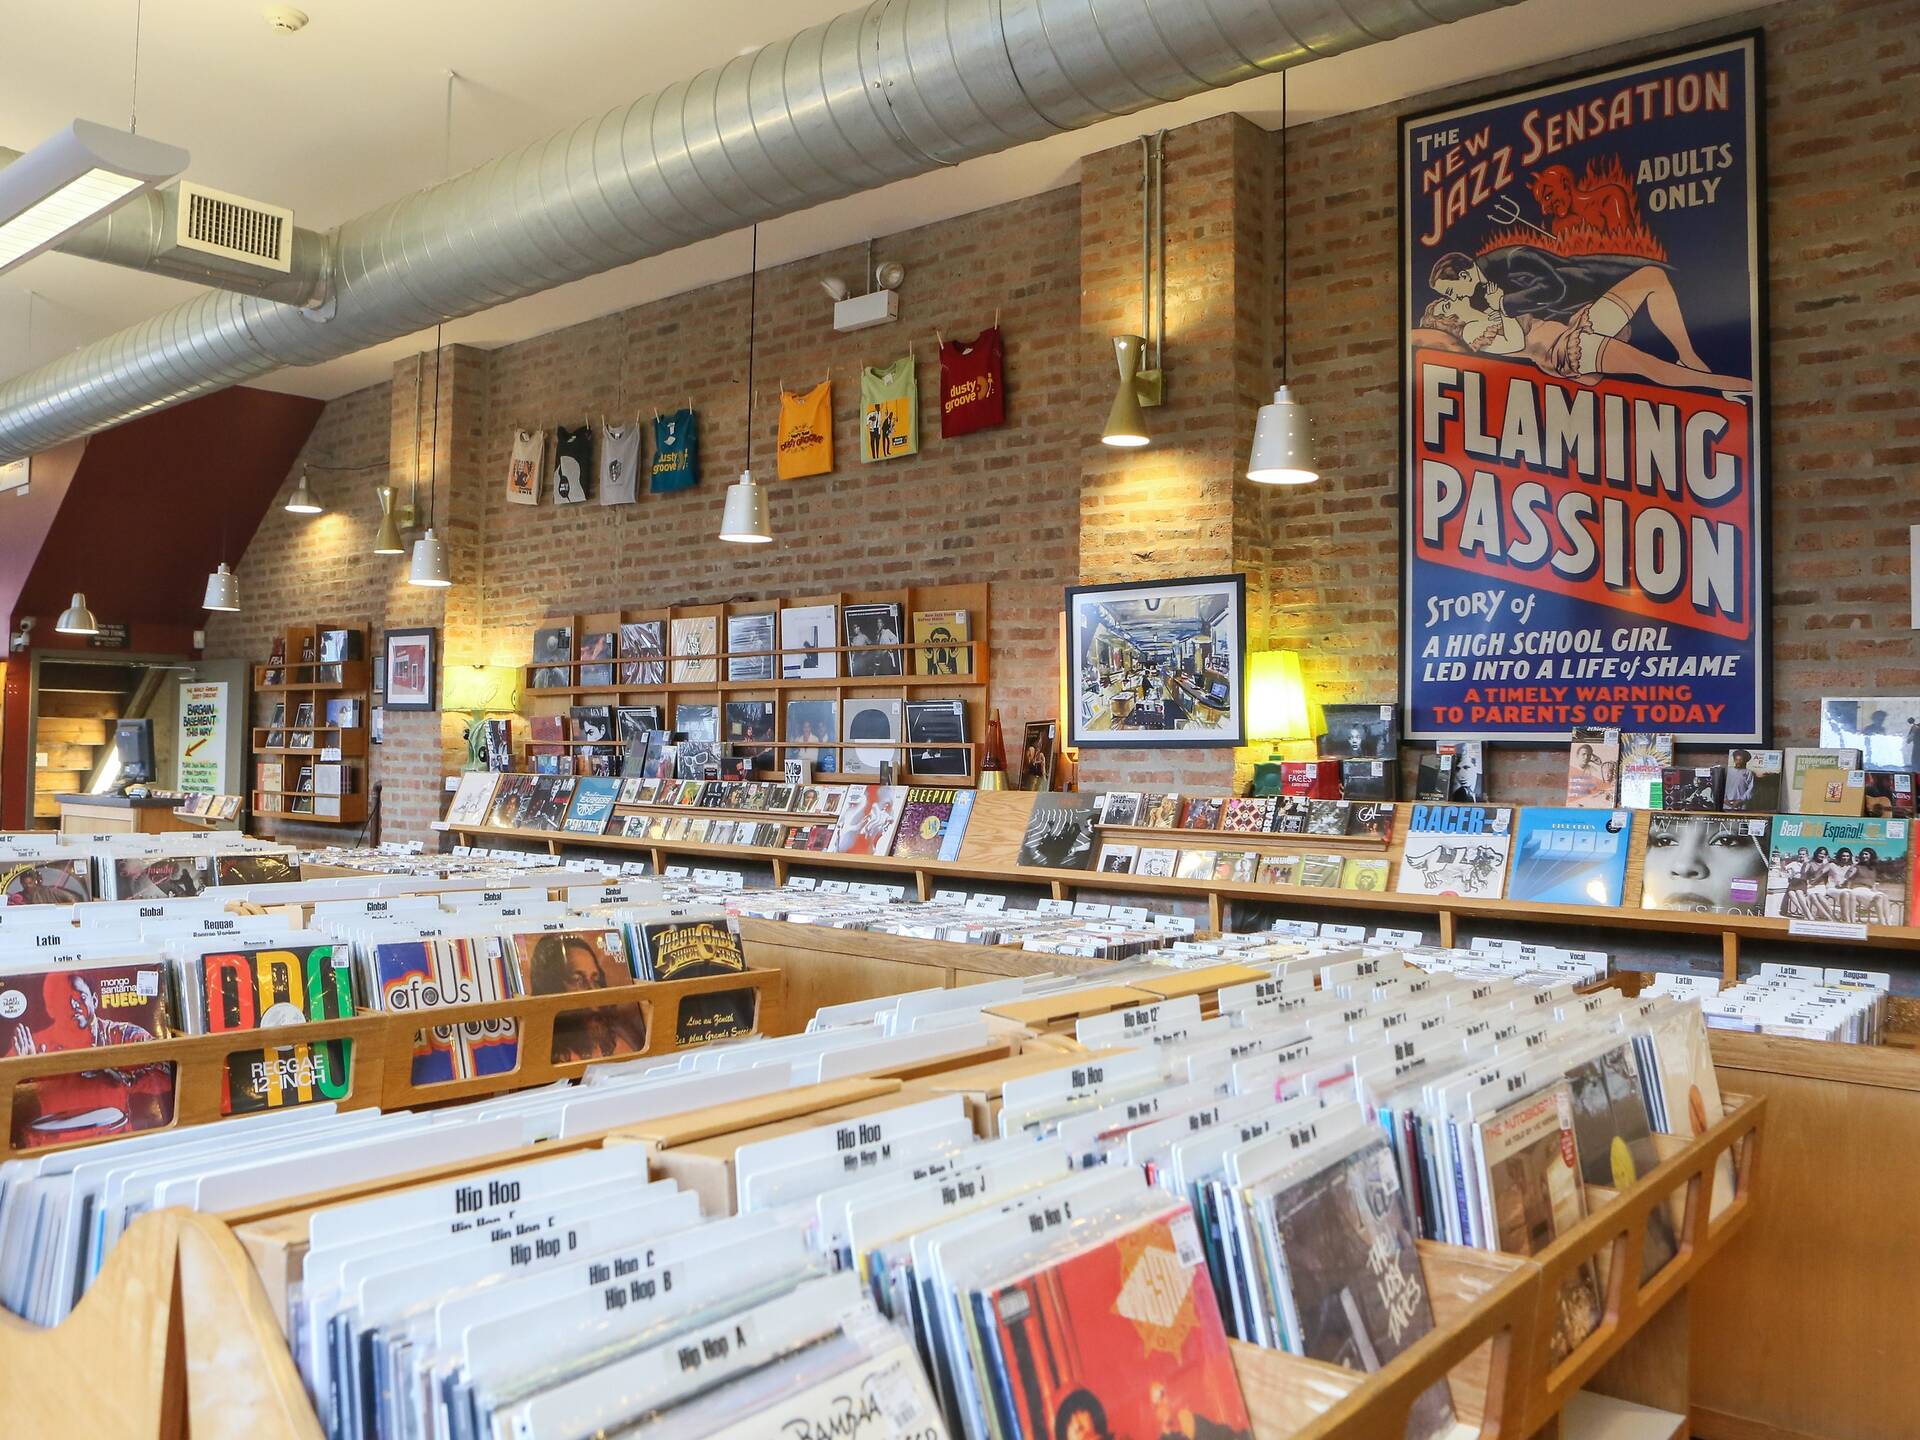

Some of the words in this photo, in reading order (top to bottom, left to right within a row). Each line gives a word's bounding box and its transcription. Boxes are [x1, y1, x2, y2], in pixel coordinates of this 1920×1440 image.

[1417, 128, 1460, 162] THE
[1420, 146, 1515, 247] JAZZ
[1521, 70, 1729, 167] SENSATION
[1422, 126, 1491, 194] NEW
[1636, 143, 1733, 185] ADULTS
[1649, 177, 1722, 213] ONLY
[949, 380, 976, 399] dusty
[945, 391, 977, 414] groove
[1422, 362, 1741, 504] FLAMING
[653, 463, 678, 476] groove
[1422, 459, 1742, 617] PASSION
[1425, 590, 1506, 627] STORY
[1511, 593, 1535, 625] of
[1422, 635, 1440, 658] A
[1444, 632, 1505, 657] HIGH
[1509, 629, 1604, 656] SCHOOL
[1611, 627, 1672, 653] GIRL
[1422, 661, 1467, 682] LED
[1472, 659, 1529, 681] INTO
[1536, 659, 1553, 680] A
[1560, 657, 1616, 679] LIFE
[1620, 656, 1641, 681] of
[1641, 655, 1741, 678] SHAME
[1463, 688, 1480, 703] A
[1485, 686, 1566, 703] TIMELY
[1576, 685, 1692, 702] WARNING
[183, 715, 217, 727] BASEMENT
[187, 704, 215, 716] BARGAIN
[1433, 707, 1464, 724] TO
[1471, 705, 1586, 724] PARENTS
[1593, 705, 1624, 723] OF
[1632, 704, 1726, 723] TODAY
[1288, 774, 1312, 784] FACES
[1780, 819, 1803, 837] Beat
[1823, 821, 1864, 843] Español!
[367, 901, 387, 911] Global
[484, 892, 502, 901] Global
[140, 907, 164, 917] Global
[204, 919, 234, 930] Reggae
[36, 935, 61, 946] Latin
[1488, 940, 1503, 948] Vocal
[1521, 945, 1537, 954] Vocal
[1569, 952, 1586, 961] Vocal
[1675, 976, 1693, 985] Latin
[1781, 966, 1797, 975] Latin
[1843, 971, 1868, 980] Reggae
[101, 979, 129, 987] mongo
[102, 991, 148, 1010] FUEGO
[687, 1015, 702, 1026] Live
[1124, 1012, 1135, 1028] Hip
[1136, 1010, 1149, 1024] Hop
[689, 1030, 703, 1044] plus
[706, 1028, 729, 1042] Grands
[251, 1055, 324, 1078] REGGAE
[1072, 1069, 1085, 1088] Hip
[1088, 1066, 1103, 1084] Hop
[252, 1070, 327, 1092] 12-INCH
[837, 1128, 856, 1151] Hip
[860, 1124, 881, 1145] Hop
[1484, 1123, 1501, 1136] THE
[844, 1155, 858, 1172] Hip
[860, 1151, 877, 1166] Hop
[882, 1145, 890, 1159] M
[456, 1186, 483, 1213] Hip
[489, 1181, 520, 1206] Hop
[942, 1186, 957, 1205] Hip
[958, 1181, 975, 1198] Hop
[980, 1176, 985, 1192] J
[1029, 1215, 1044, 1232] Hip
[1045, 1209, 1062, 1226] Hop
[510, 1245, 532, 1266] Hip
[536, 1237, 560, 1257] Hop
[568, 1231, 576, 1250] D
[1366, 1227, 1398, 1276] THE
[589, 1264, 610, 1285] Hip
[614, 1257, 638, 1276] Hop
[647, 1250, 654, 1267] C
[1377, 1247, 1405, 1312] LOST
[606, 1288, 627, 1311] Hip
[631, 1281, 655, 1302] Hop
[663, 1271, 672, 1291] B
[1388, 1273, 1422, 1345] TAPES
[678, 1348, 700, 1371] Hip
[703, 1337, 728, 1360] Hop
[736, 1326, 746, 1346] A
